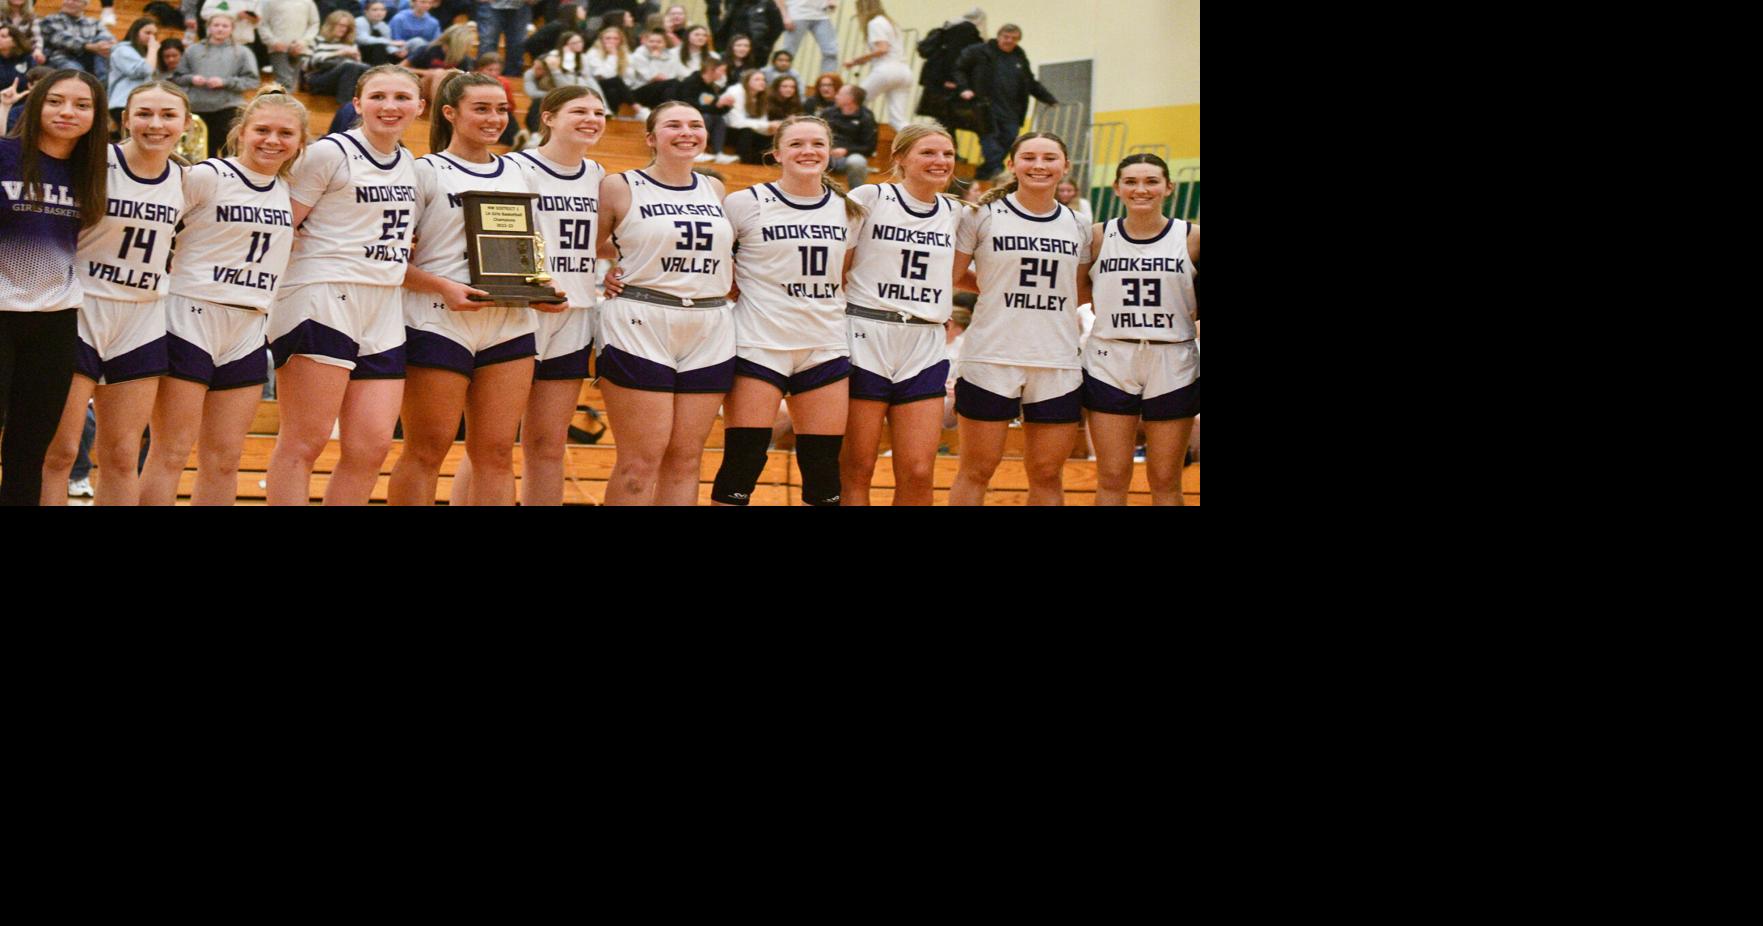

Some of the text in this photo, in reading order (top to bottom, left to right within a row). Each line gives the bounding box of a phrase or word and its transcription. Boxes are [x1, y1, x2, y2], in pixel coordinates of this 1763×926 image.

[379, 209, 410, 240] 25
[560, 219, 591, 250] 50
[674, 221, 713, 251] 35
[762, 225, 847, 242] NOOKSACK
[872, 224, 952, 248] NOOKSACK
[117, 226, 157, 264] 14
[245, 231, 272, 263] 11
[992, 236, 1078, 256] NOOKSACK
[88, 260, 161, 291] VALLEY
[661, 257, 720, 275] VALLEY
[798, 246, 828, 276] 10
[901, 249, 930, 280] 15
[1019, 257, 1059, 289] 24
[1100, 258, 1184, 274] NOOKSACK
[213, 265, 278, 291] VALLEY
[1121, 278, 1161, 307] 33
[877, 282, 942, 304] VALLEY
[1004, 293, 1067, 312] VALLEY
[1111, 313, 1174, 328] VALLEY
